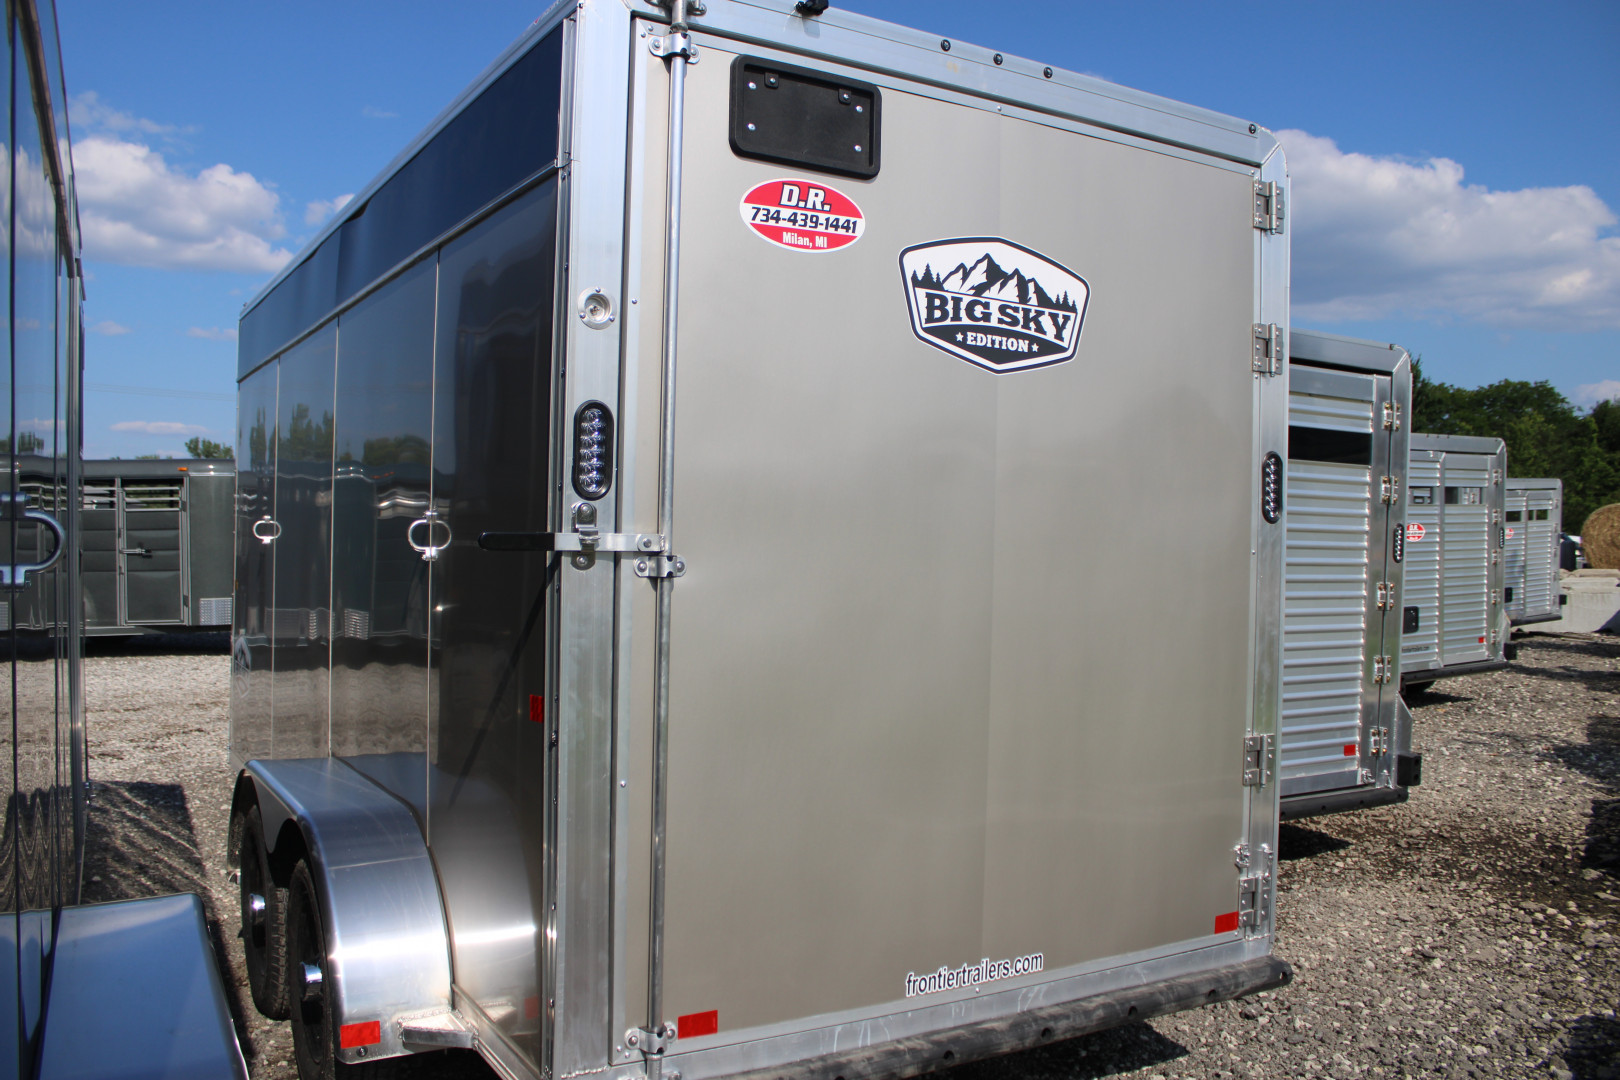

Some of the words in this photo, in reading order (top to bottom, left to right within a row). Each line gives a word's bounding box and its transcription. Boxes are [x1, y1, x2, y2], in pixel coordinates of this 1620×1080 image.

[779, 182, 832, 212] D.R.
[751, 206, 857, 233] 734-439-1441
[782, 231, 812, 248] Milan,
[815, 235, 828, 248] MI
[925, 292, 992, 325] BIG
[998, 303, 1071, 343] SKY
[966, 331, 1029, 353] EDITION
[906, 953, 1043, 997] frontiertrailers.com
